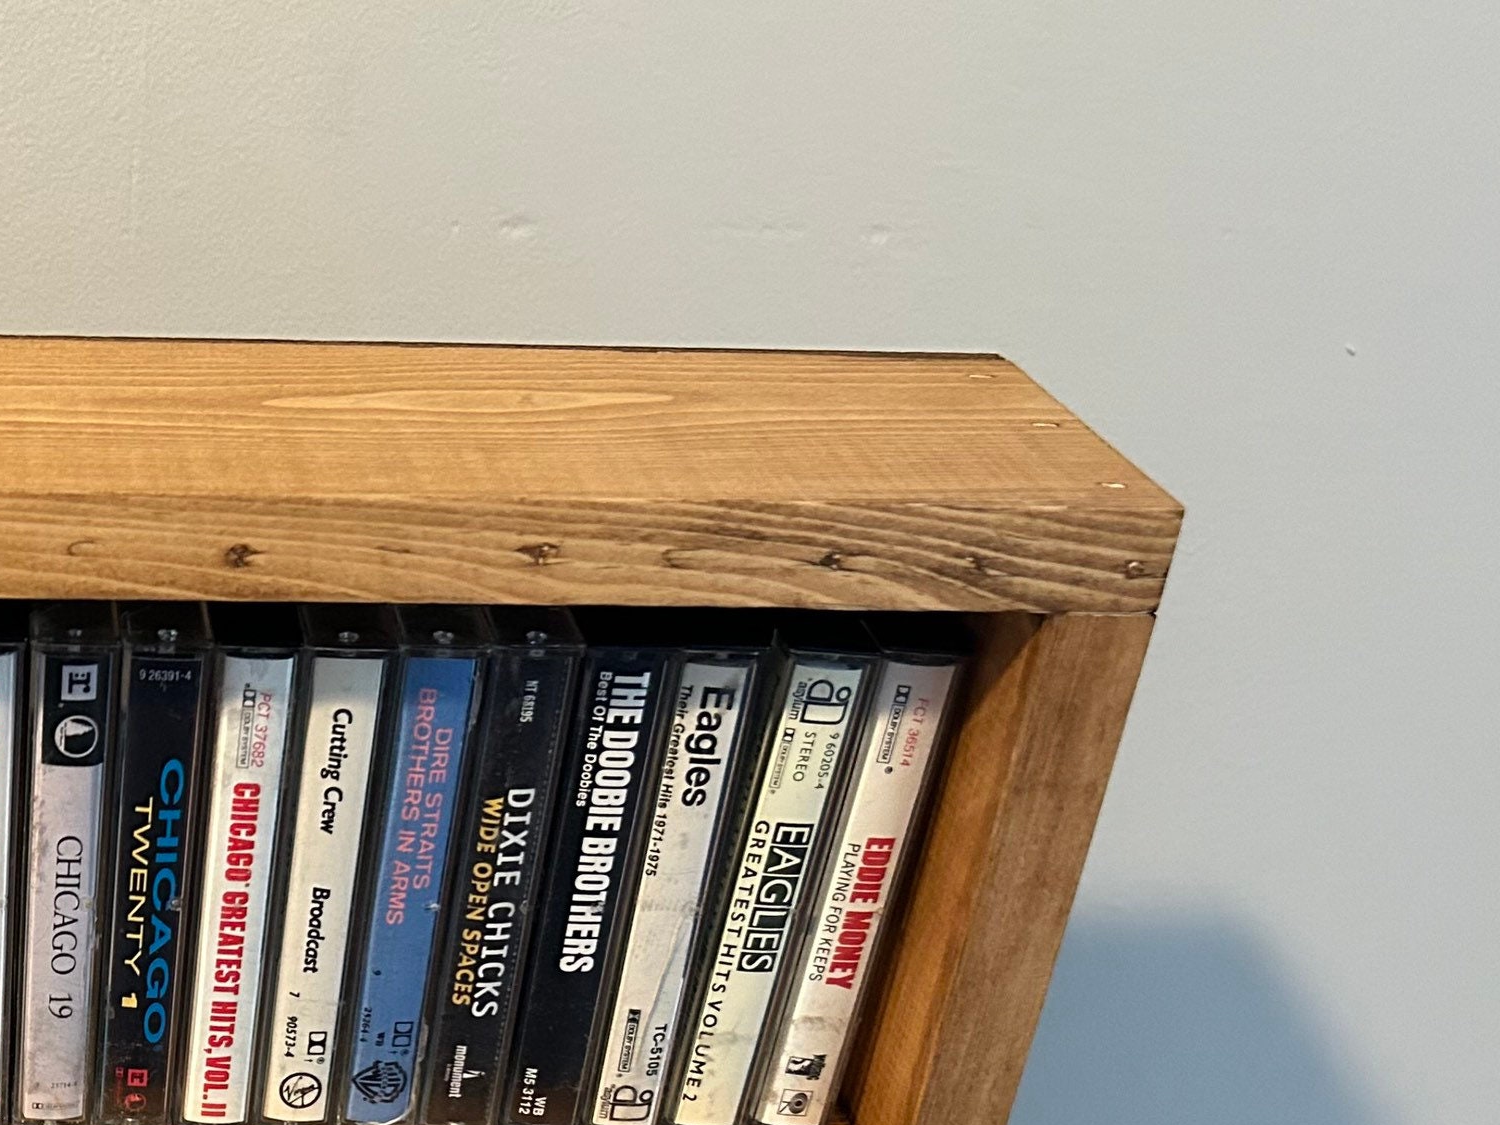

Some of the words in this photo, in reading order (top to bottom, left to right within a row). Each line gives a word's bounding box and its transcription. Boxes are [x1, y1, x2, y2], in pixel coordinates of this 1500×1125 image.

[254, 691, 272, 720] PCT
[605, 671, 651, 724] THE
[674, 684, 695, 719] Their
[249, 723, 269, 767] 37682
[320, 707, 354, 781] Cutting
[426, 727, 453, 784] DIRE
[661, 722, 686, 779] Greatest
[670, 685, 736, 807] Eagles
[790, 731, 816, 782] STEREO
[318, 785, 343, 834] Crew
[584, 729, 639, 831] DOOBIE
[655, 783, 673, 809] Hits
[224, 782, 261, 880] CHICAGO
[411, 792, 444, 889] STRAITS
[491, 787, 535, 887] DIXIE
[642, 812, 669, 876] 1971-1975
[48, 834, 84, 975] CHICAGO
[121, 796, 154, 976] TWENTY
[137, 758, 190, 1044] CHICAGO
[557, 836, 619, 972] BROTHERS
[724, 819, 772, 938] GREATEST
[735, 822, 815, 973] EAGLES
[847, 836, 896, 904] EDDIE
[212, 890, 250, 994] GREATEST
[300, 886, 331, 974] Broadcast
[469, 900, 516, 1018] CHICKS
[822, 910, 874, 990] MONEY
[120, 991, 138, 1009] 1
[709, 943, 739, 993] HITS
[46, 992, 74, 1019] 19
[446, 1044, 469, 1098] monument
[643, 1023, 669, 1077] TC-5105
[684, 999, 723, 1088] VOLUME
[680, 1092, 697, 1102] 2
